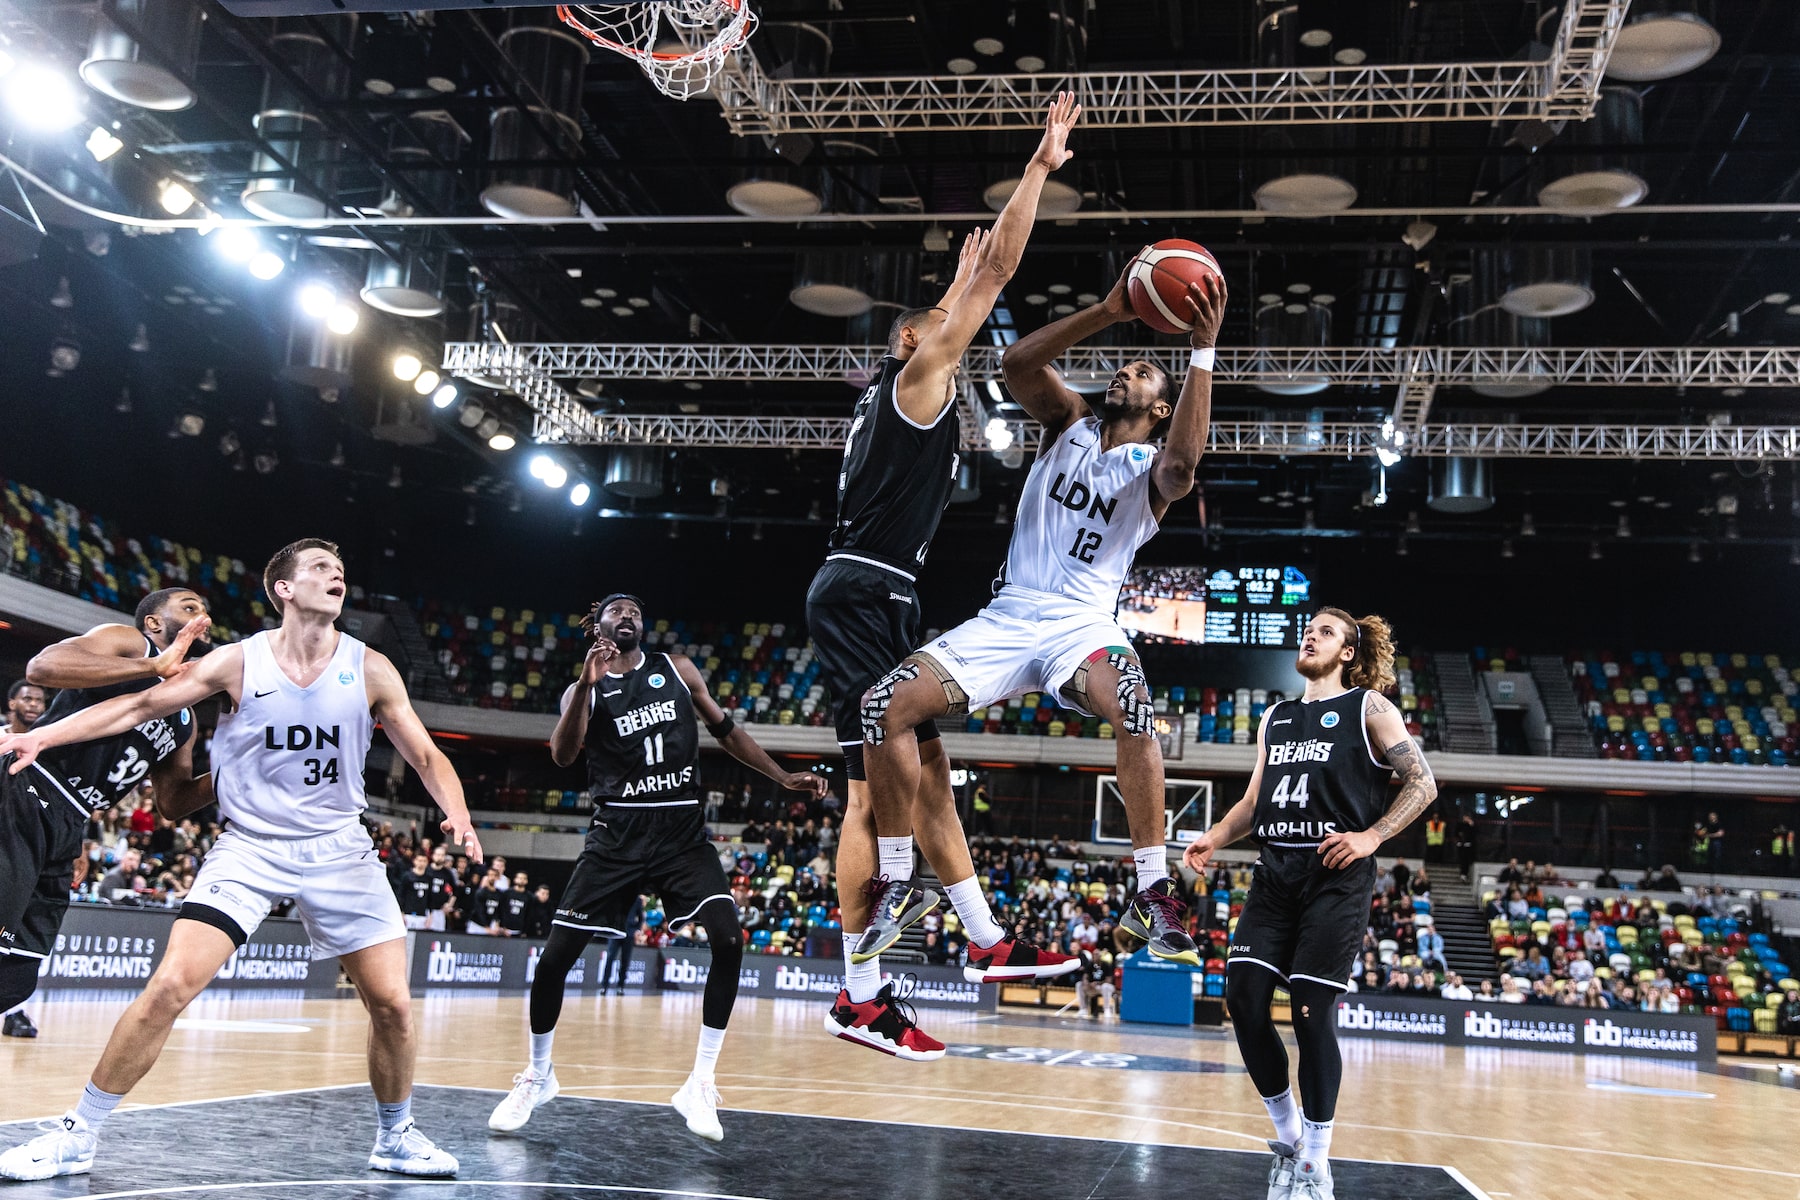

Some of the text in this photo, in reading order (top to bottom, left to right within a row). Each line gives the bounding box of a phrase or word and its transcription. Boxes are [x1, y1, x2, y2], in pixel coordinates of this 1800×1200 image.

[1048, 472, 1119, 526] LDN
[1068, 527, 1103, 565] 12
[613, 700, 677, 737] BEARS
[627, 701, 661, 716] BAKKEN
[265, 724, 340, 751] LDN
[643, 733, 665, 766] 11
[1285, 738, 1318, 747] BAKKEN
[1267, 742, 1335, 766] BEARS
[107, 745, 150, 791] 32
[303, 757, 339, 786] 34
[621, 765, 693, 798] AARHUS
[1271, 773, 1310, 809] 44
[55, 934, 156, 954] BUILDERS
[238, 942, 312, 959] BUILDERS
[51, 954, 153, 978] MERCHANTS
[235, 960, 309, 980] MERCHANTS
[427, 941, 457, 982] ibb
[456, 952, 503, 966] BUILDERS
[455, 965, 502, 983] MERCHANTS
[664, 957, 697, 984] ibb
[775, 965, 809, 991] ibb
[915, 980, 980, 992] BUILDERS
[914, 989, 980, 1004] MERCHANTS
[1338, 1002, 1446, 1031] ibb BUILDERS
[1374, 1020, 1446, 1036] MERCHANTS
[1464, 1010, 1576, 1039] ibb BUILDERS
[1502, 1028, 1576, 1044] MERCHANTS
[1584, 1018, 1698, 1048] ibb BUILDERS
[1622, 1036, 1698, 1053] MERCHANTS
